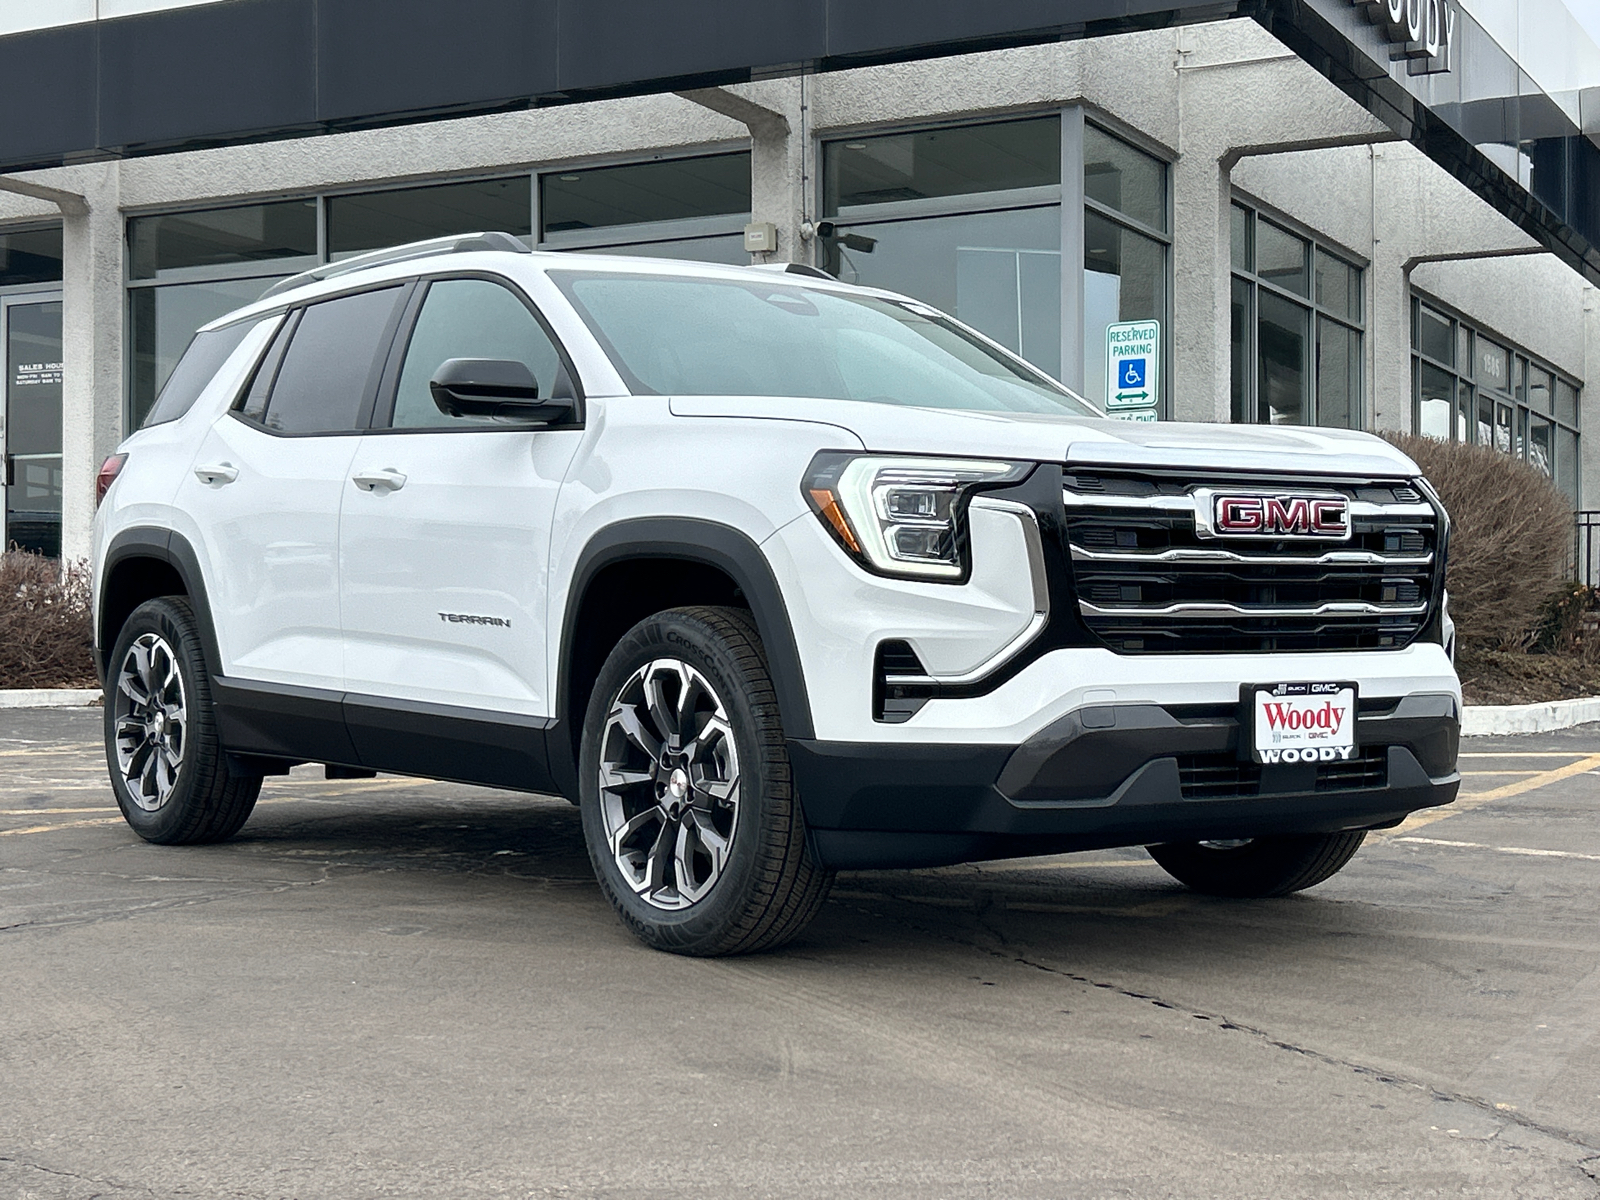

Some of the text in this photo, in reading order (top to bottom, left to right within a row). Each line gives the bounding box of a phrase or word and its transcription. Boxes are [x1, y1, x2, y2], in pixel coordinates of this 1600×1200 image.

[1110, 328, 1155, 342] RESERVED
[1113, 343, 1152, 357] PARKING
[18, 363, 43, 371] SALES
[1217, 497, 1348, 534] GMC
[437, 612, 512, 628] TERRAIN
[1311, 683, 1337, 692] GMC
[1262, 701, 1346, 735] Woody
[1308, 731, 1328, 739] GMC
[1259, 745, 1354, 764] WOODY
